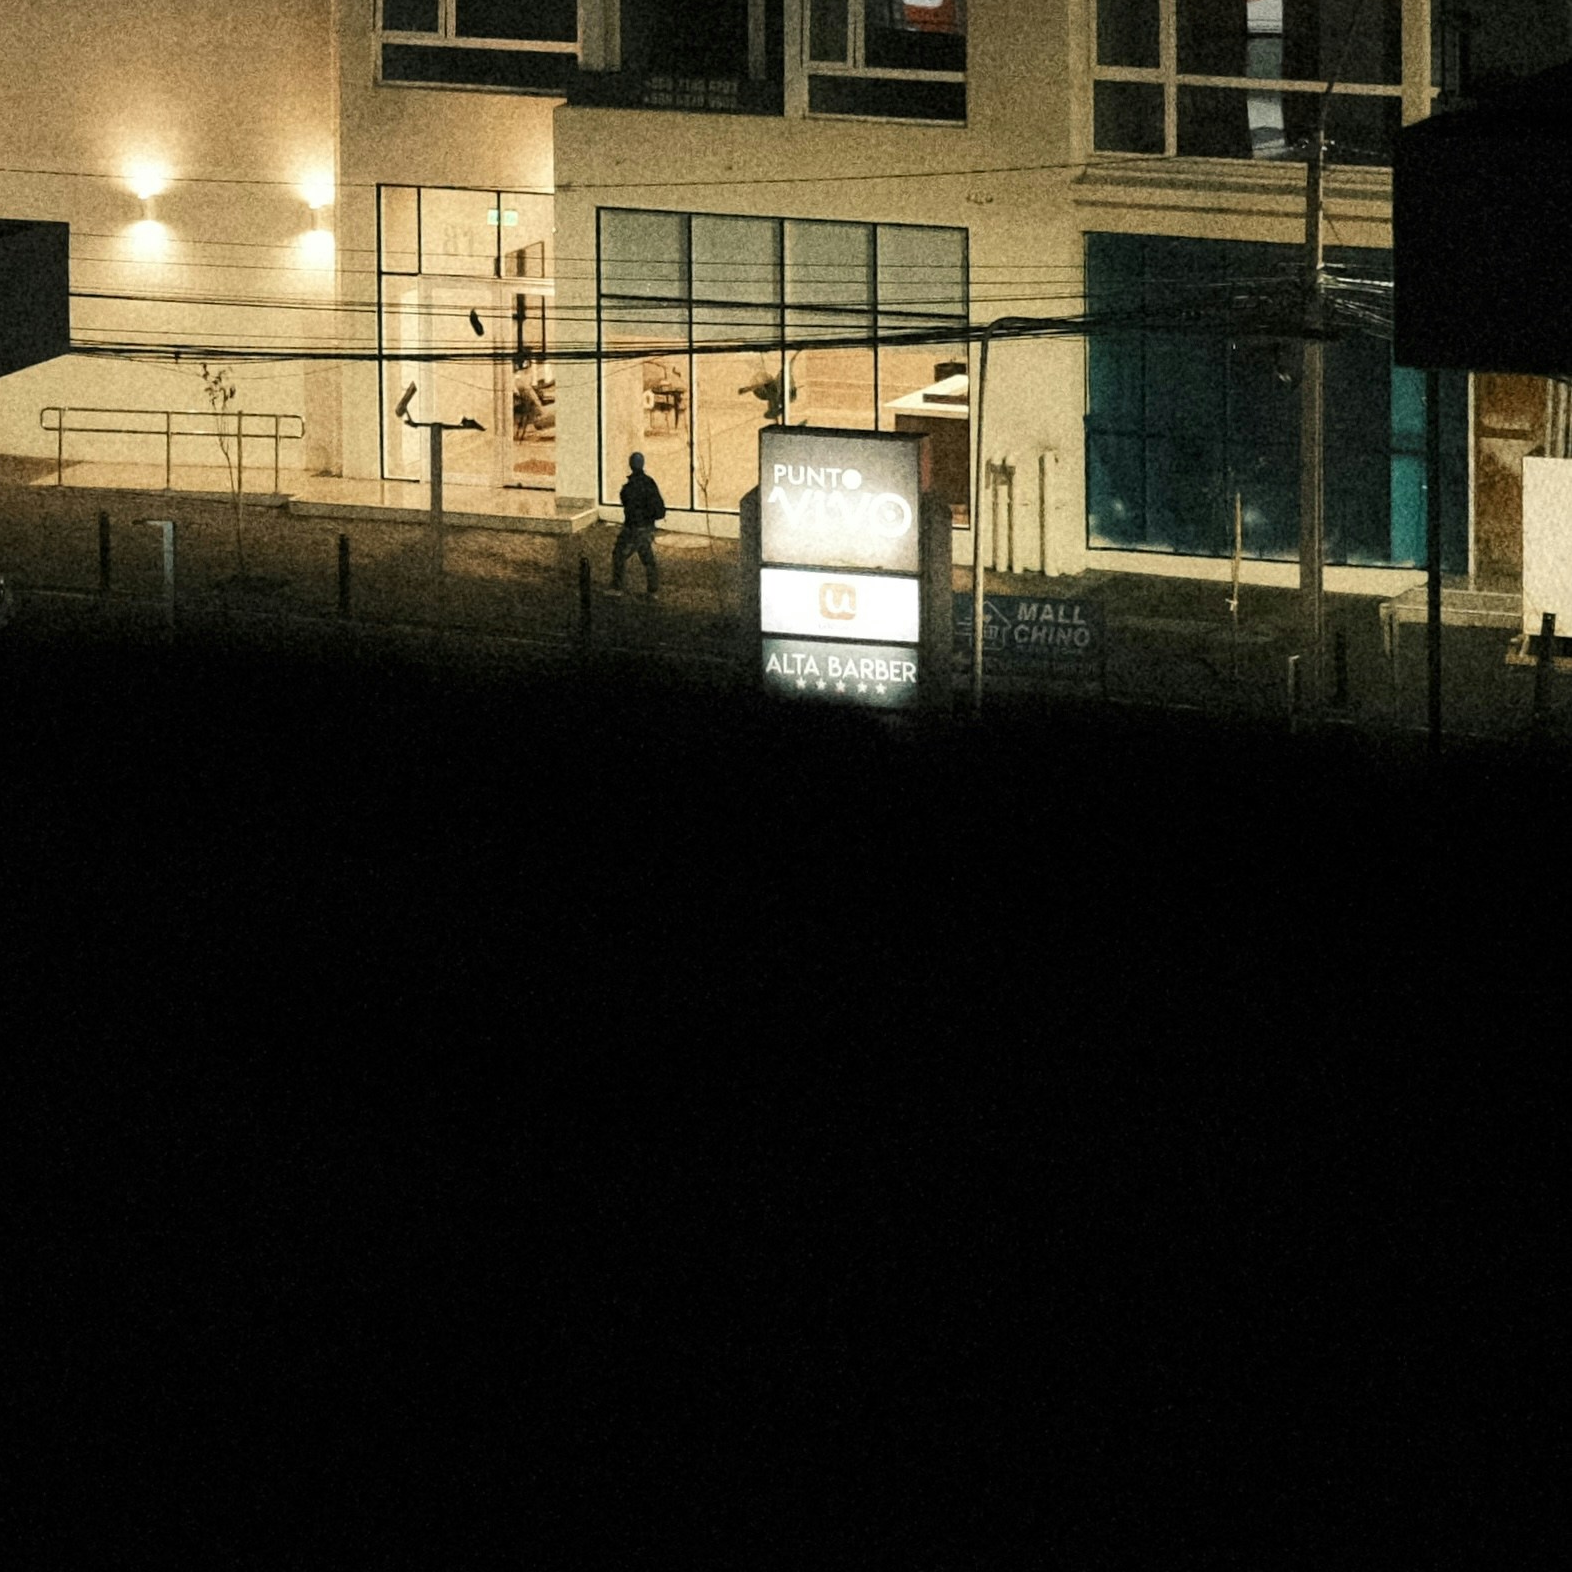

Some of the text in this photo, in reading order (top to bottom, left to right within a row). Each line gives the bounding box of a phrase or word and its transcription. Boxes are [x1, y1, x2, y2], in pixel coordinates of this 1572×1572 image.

[773, 464, 863, 490] PUNTO
[1017, 602, 1087, 625] MALL
[1012, 623, 1091, 647] CHINO
[765, 652, 918, 684] ALTA BARBER
